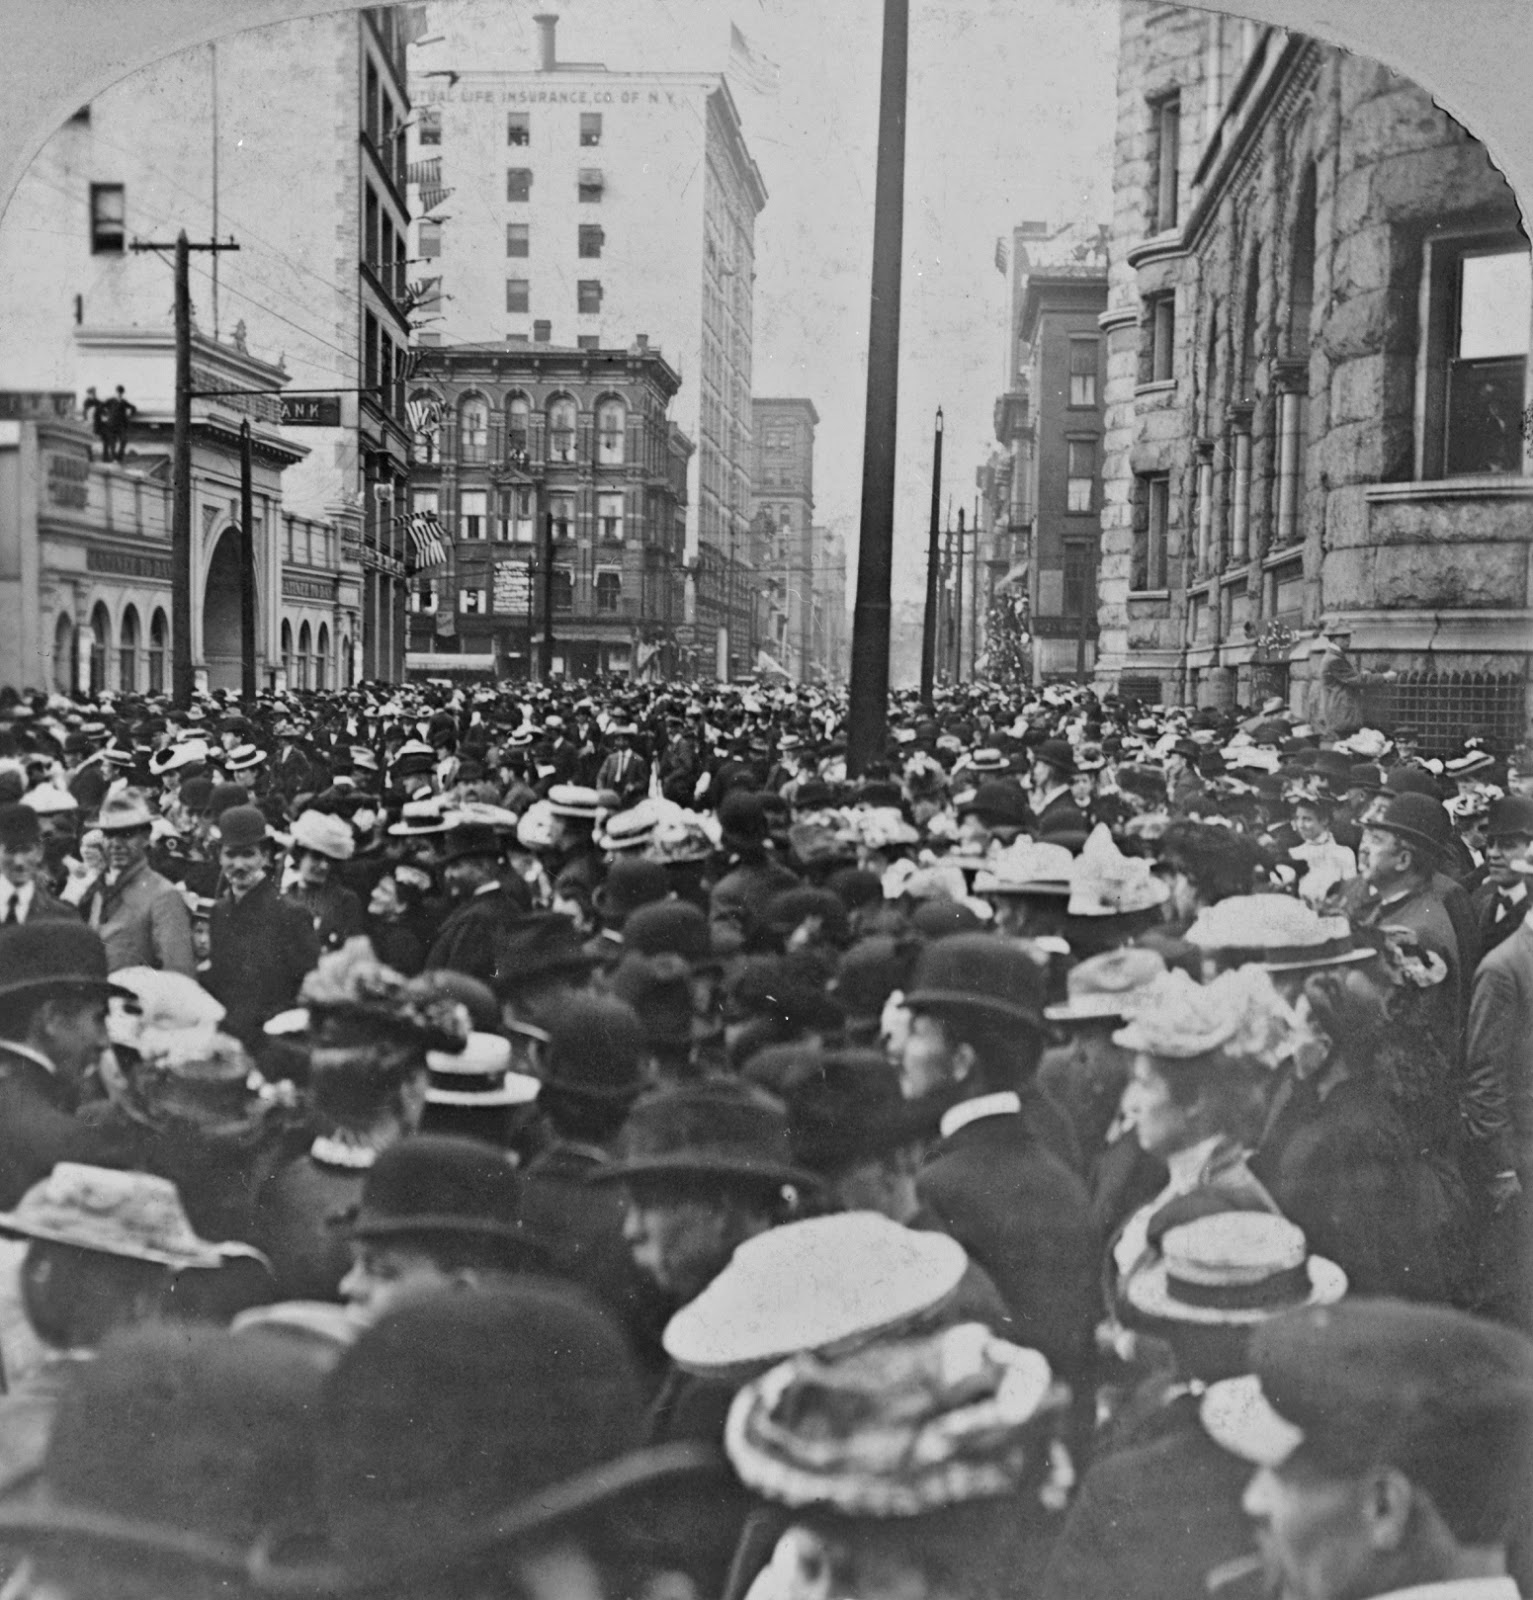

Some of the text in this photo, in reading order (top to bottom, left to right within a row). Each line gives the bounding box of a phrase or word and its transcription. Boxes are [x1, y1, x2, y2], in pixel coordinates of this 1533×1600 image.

[410, 90, 455, 103] UTUAL
[460, 90, 494, 103] LIFE
[620, 90, 640, 103] OF
[280, 402, 320, 418] ANK
